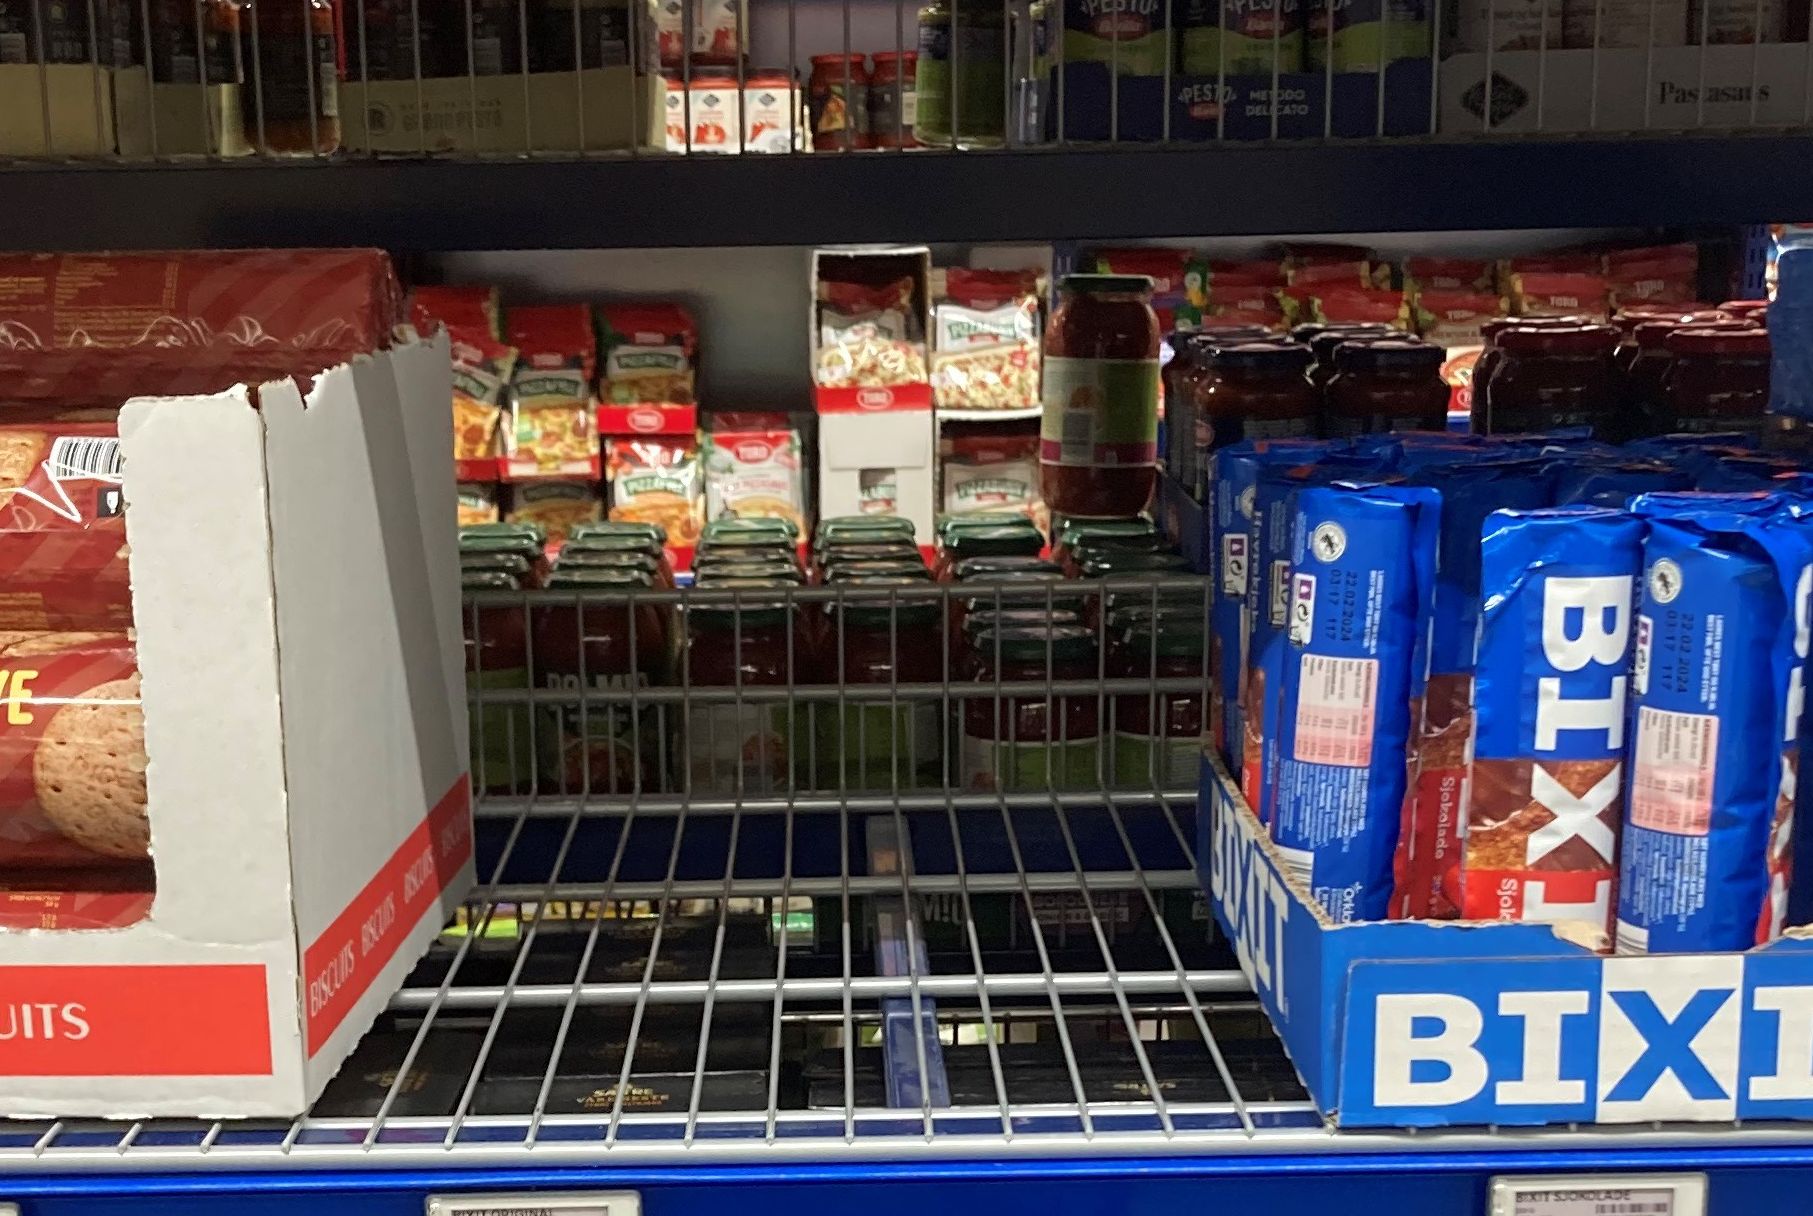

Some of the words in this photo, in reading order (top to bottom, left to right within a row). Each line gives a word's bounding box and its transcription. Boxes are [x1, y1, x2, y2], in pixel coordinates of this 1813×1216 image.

[1182, 84, 1232, 104] PESTO
[1658, 81, 1770, 104] Pasasas
[1245, 104, 1309, 117] DELCATO
[1434, 776, 1455, 860] Sjokolade
[1210, 777, 1289, 1016] BIXIT
[309, 938, 355, 1018] BISCUITS
[361, 891, 396, 957] BISCUITS
[404, 844, 436, 904] BISCUITS
[1516, 1191, 1550, 1203] BIXIT
[1553, 1190, 1631, 1202] SJOKOLADE
